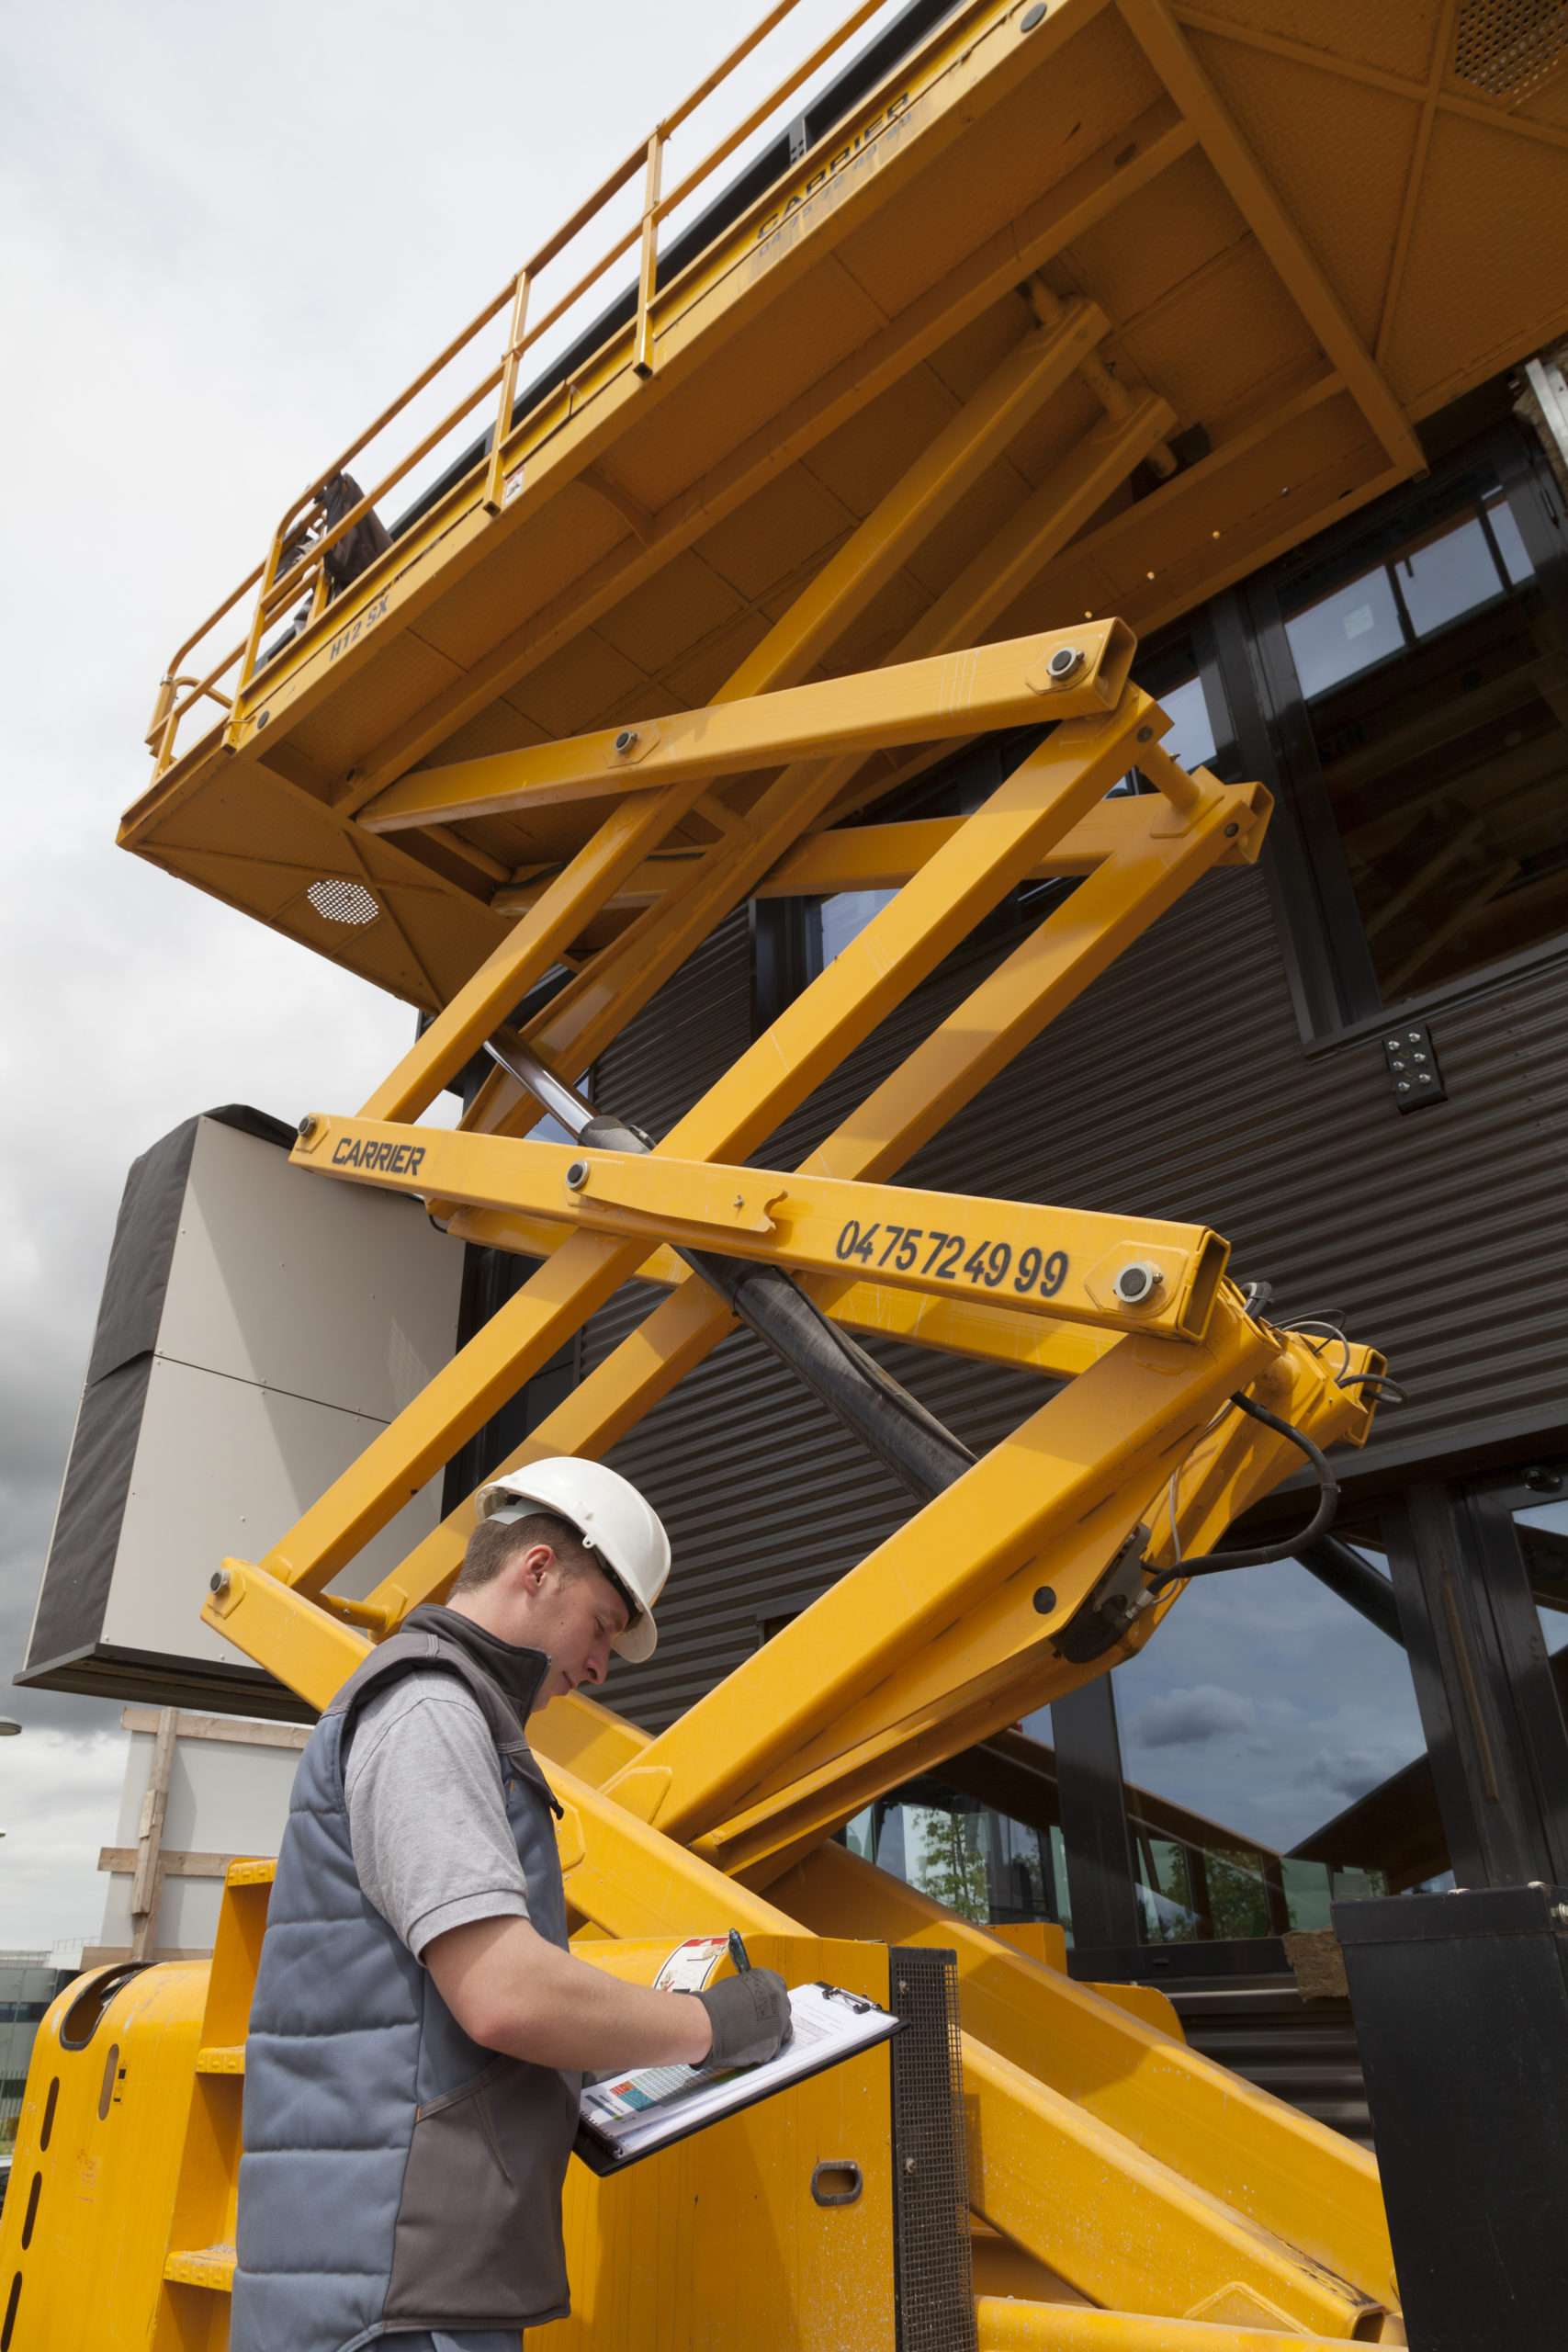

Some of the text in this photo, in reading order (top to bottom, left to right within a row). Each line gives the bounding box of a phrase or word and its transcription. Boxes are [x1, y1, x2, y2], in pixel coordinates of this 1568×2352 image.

[758, 93, 908, 239] CARRIER
[330, 594, 389, 662] H12 SX
[332, 1137, 426, 1176] CARRIER
